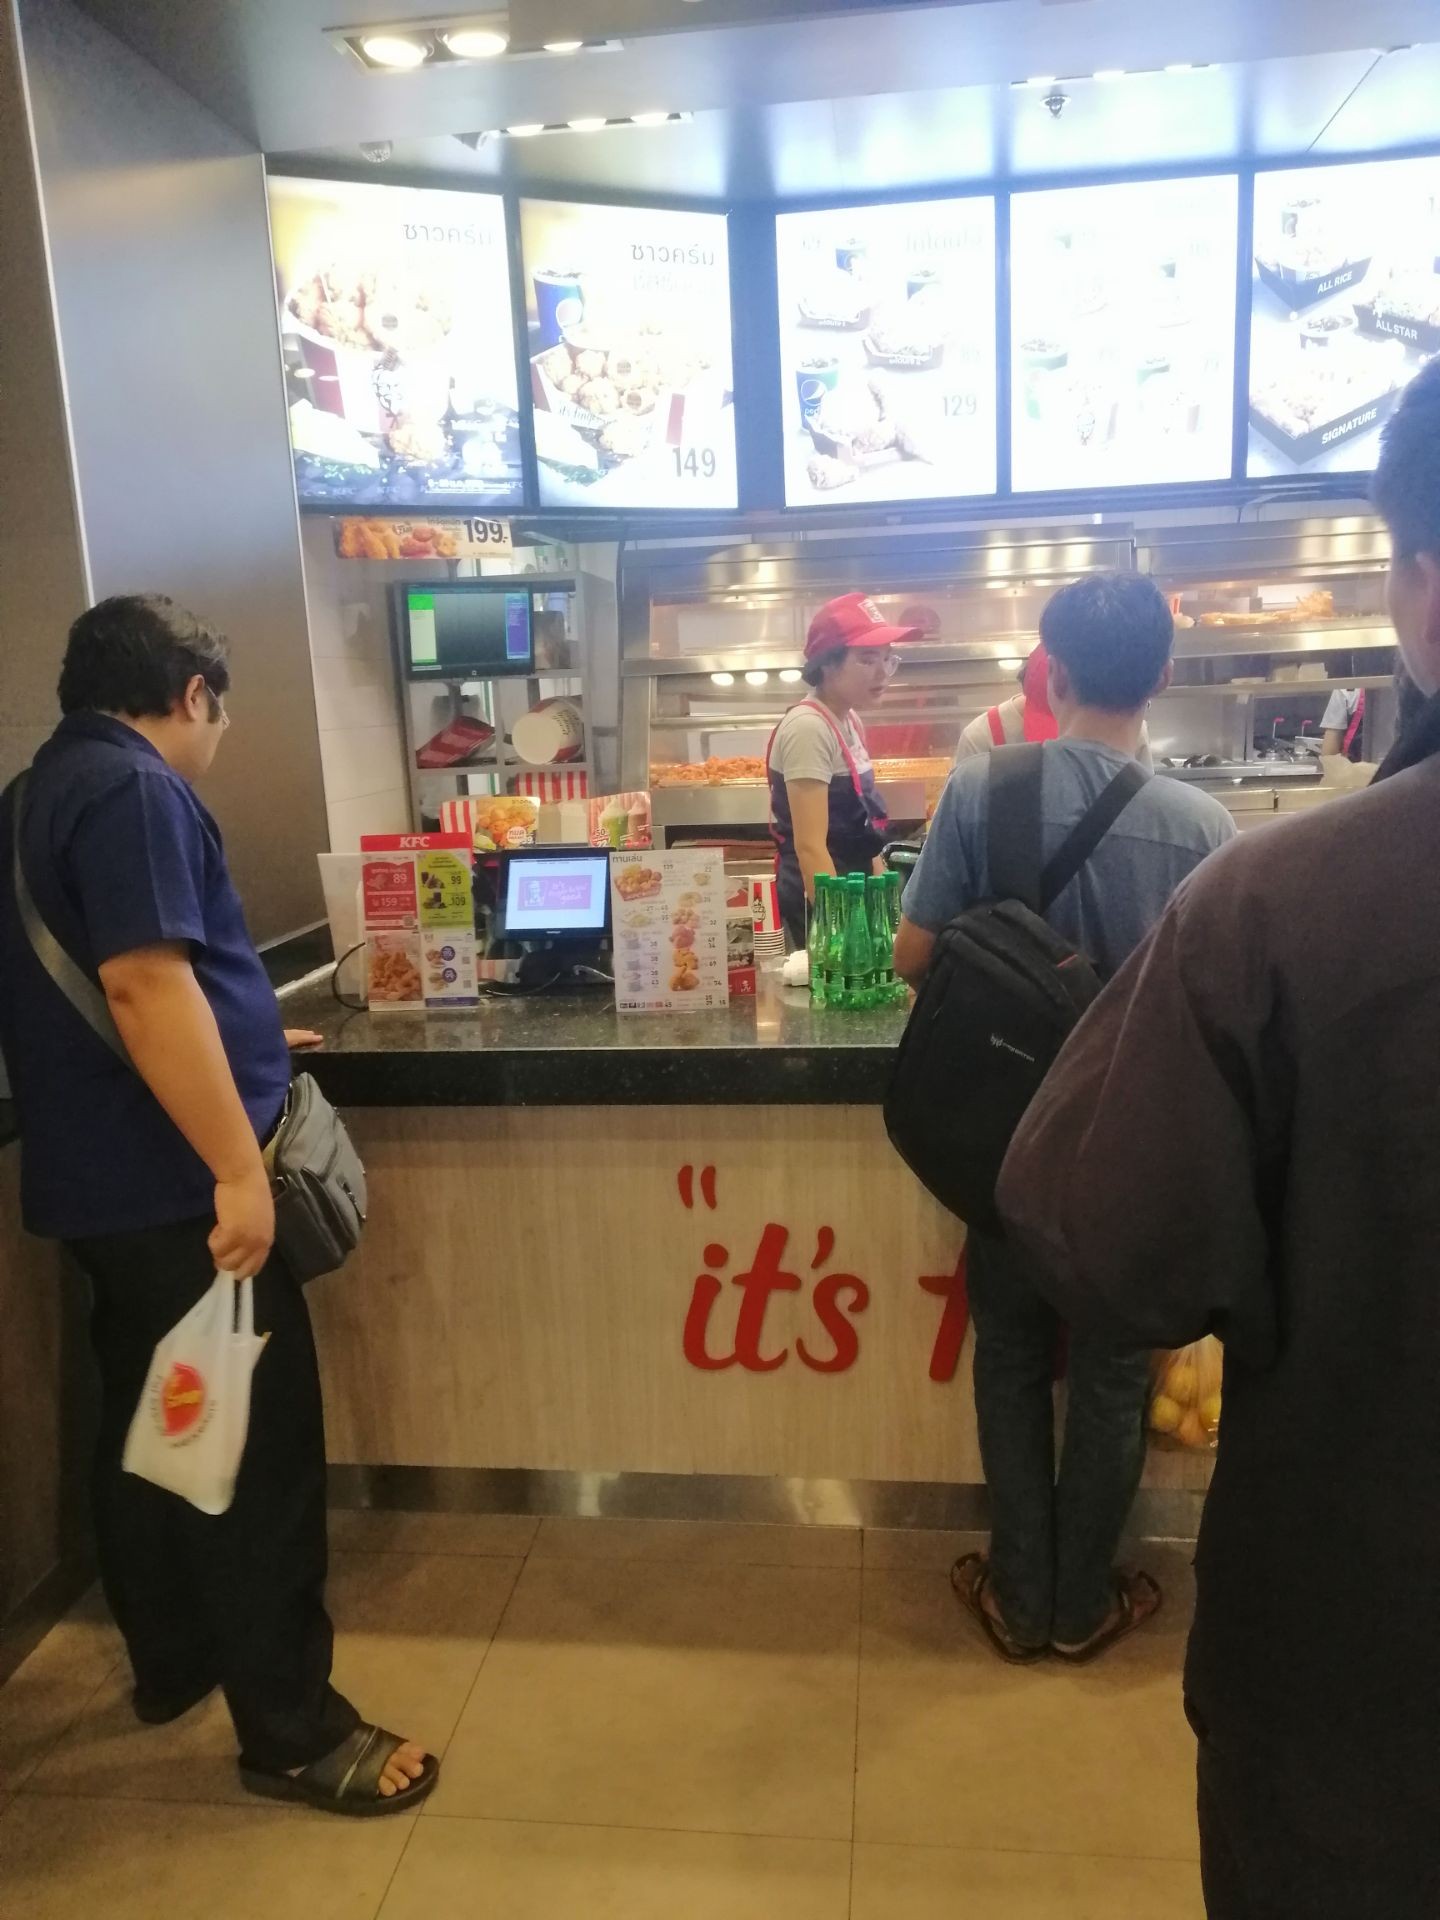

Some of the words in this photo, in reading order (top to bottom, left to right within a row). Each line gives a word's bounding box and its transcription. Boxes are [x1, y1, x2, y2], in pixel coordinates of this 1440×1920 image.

[1317, 281, 1334, 294] ALL
[1334, 270, 1353, 287] RICE
[1376, 319, 1393, 332] ALL
[1393, 324, 1418, 340] STAR
[942, 394, 978, 418] 129
[1321, 407, 1378, 445] SIGNATURE
[672, 447, 717, 478] 149
[399, 836, 431, 848] KFC
[392, 873, 408, 884] 89
[450, 875, 462, 885] 99
[381, 896, 398, 907] 159
[683, 1223, 870, 1374] it's
